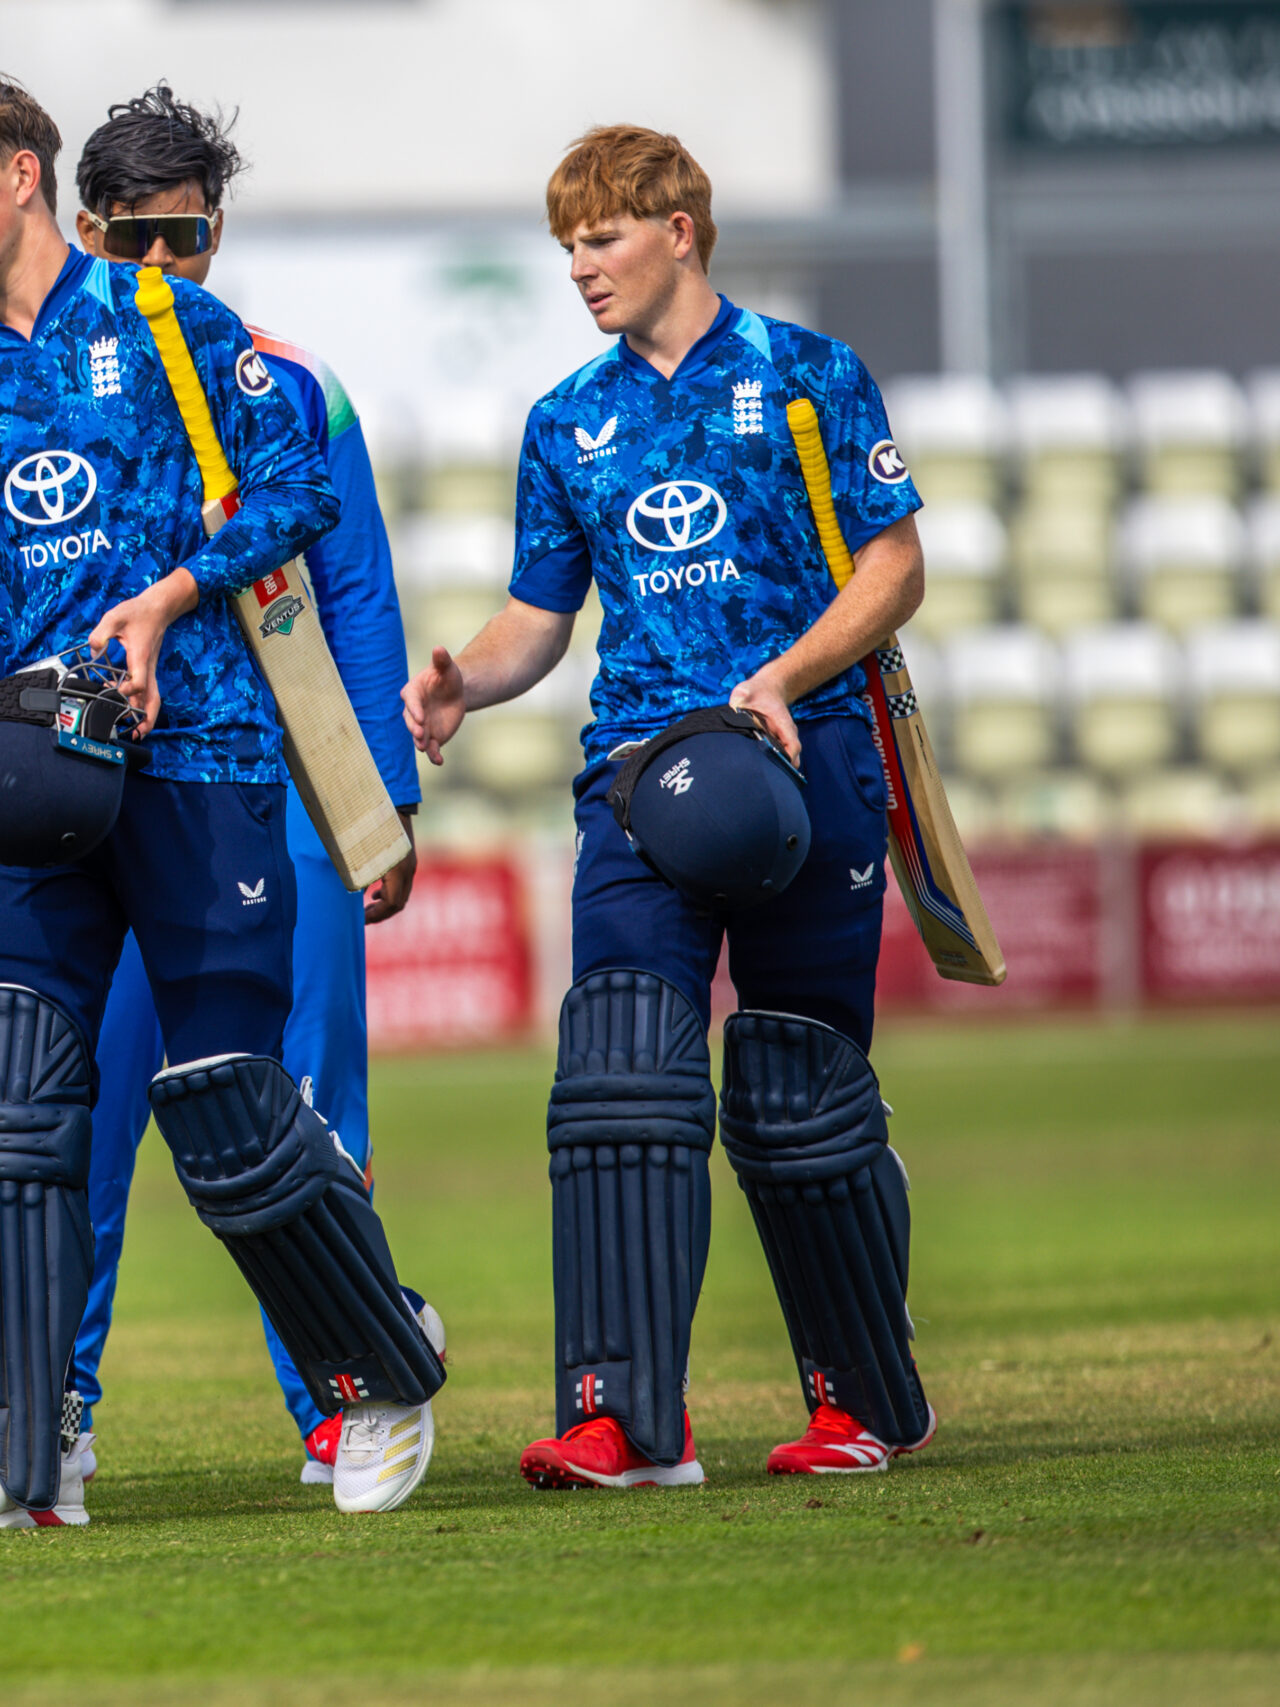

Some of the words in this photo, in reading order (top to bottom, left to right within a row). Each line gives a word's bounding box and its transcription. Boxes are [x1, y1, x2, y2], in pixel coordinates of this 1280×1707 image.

[577, 446, 617, 464] CASTORE
[877, 448, 906, 475] K
[19, 528, 113, 570] TOYOTA
[632, 558, 741, 597] TOYOTA
[264, 602, 300, 632] VENTUS
[659, 757, 691, 789] SHREY
